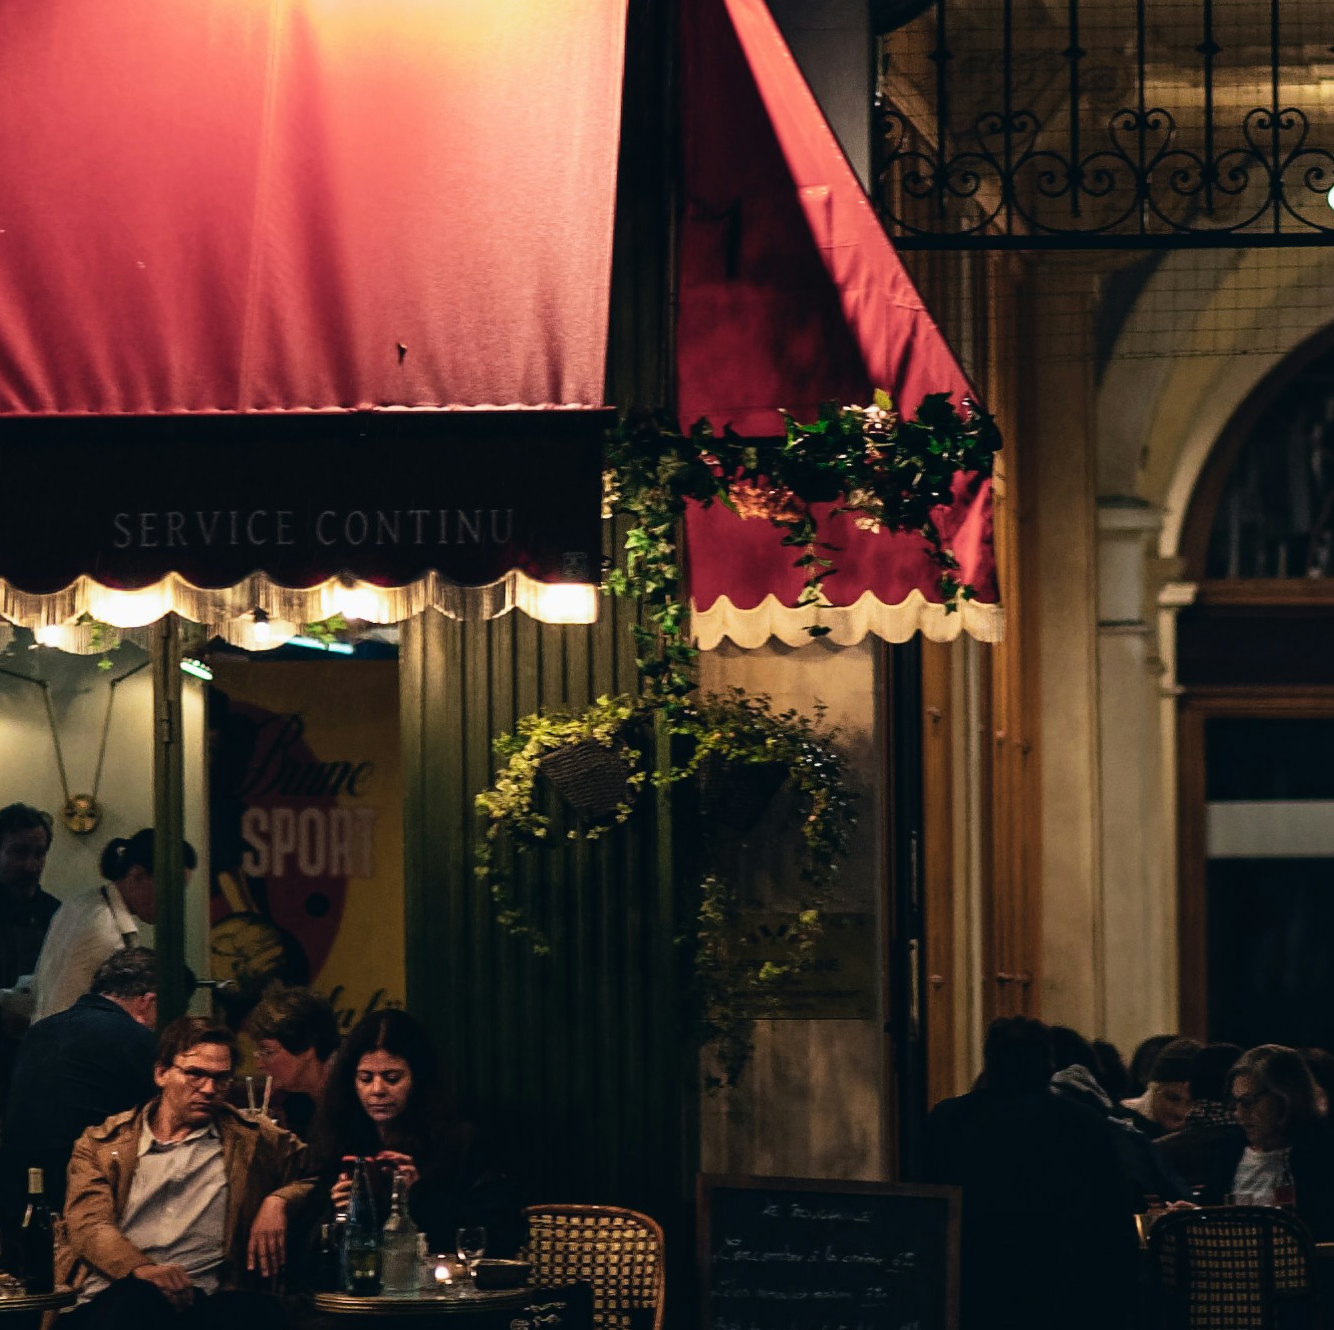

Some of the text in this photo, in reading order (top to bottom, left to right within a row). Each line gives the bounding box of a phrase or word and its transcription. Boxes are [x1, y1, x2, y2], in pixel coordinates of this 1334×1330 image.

[113, 508, 515, 549] SERVICE CONTINU
[240, 805, 378, 879] SPORT
